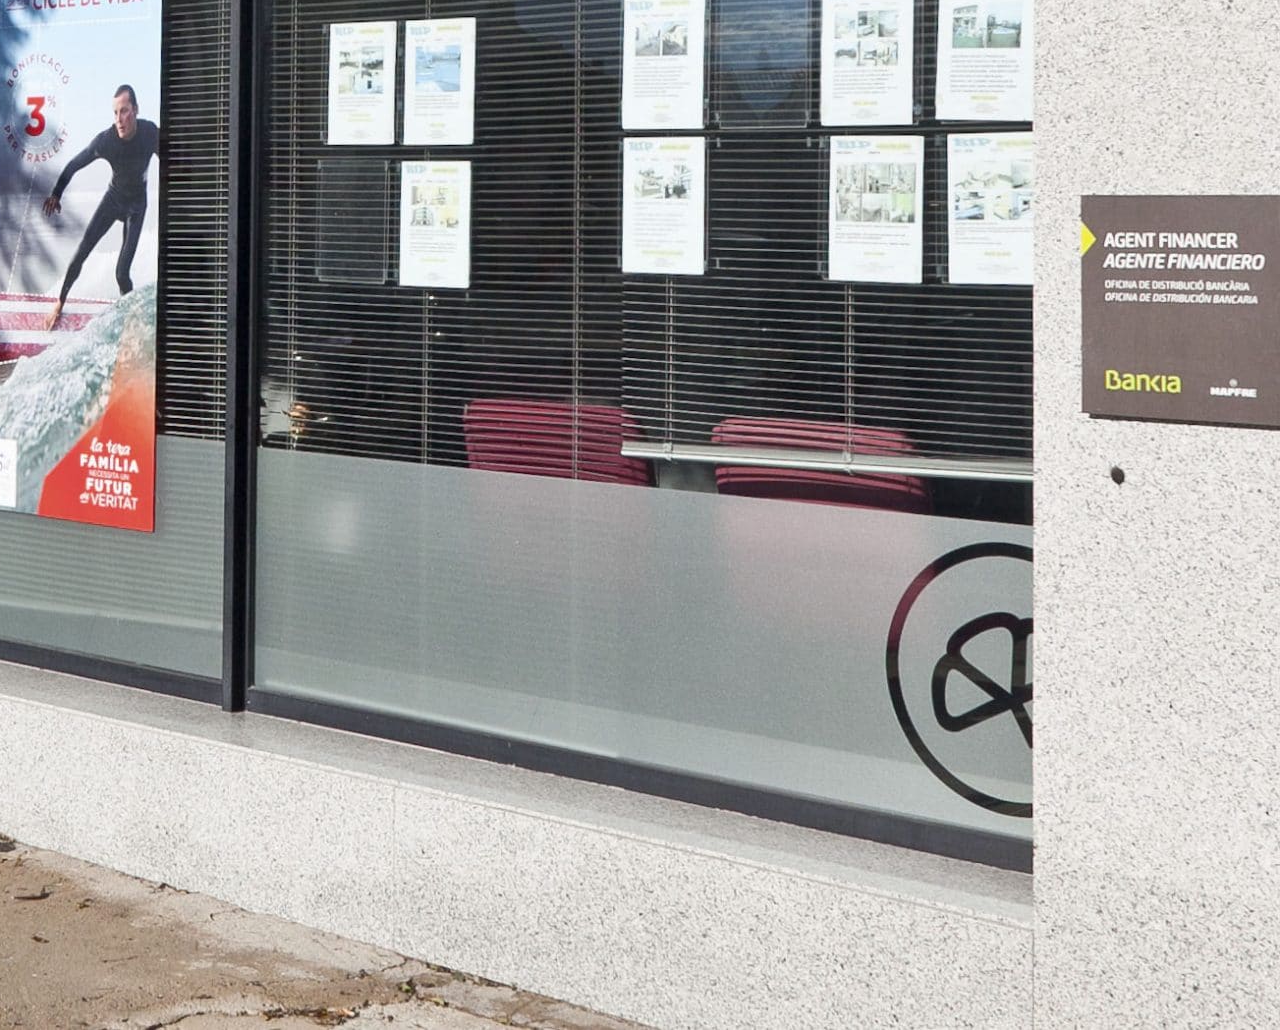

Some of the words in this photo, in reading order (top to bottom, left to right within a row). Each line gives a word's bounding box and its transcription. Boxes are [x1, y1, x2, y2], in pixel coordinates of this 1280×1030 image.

[1104, 232, 1156, 249] AGENT
[1158, 232, 1238, 249] FINANCER
[1103, 253, 1167, 269] AGENTE
[1167, 254, 1266, 270] FINANCIERO
[1104, 280, 1137, 289] OFICINA
[1138, 280, 1151, 289] DE
[1152, 279, 1204, 291] DISTRIBUCIÓ
[1205, 279, 1250, 291] BANCÀRIA
[1104, 292, 1137, 302] OFICINA
[1139, 293, 1151, 302] DE
[1152, 293, 1212, 304] DISTRIBUCIÓN
[1213, 294, 1258, 304] BANCARIA
[1105, 369, 1182, 393] Bankia
[1209, 386, 1258, 398] MAPFRE
[90, 436, 103, 452] la
[80, 453, 139, 474] FAMÍLIA
[86, 477, 132, 496] FUTUR
[90, 492, 139, 511] VERITAT
